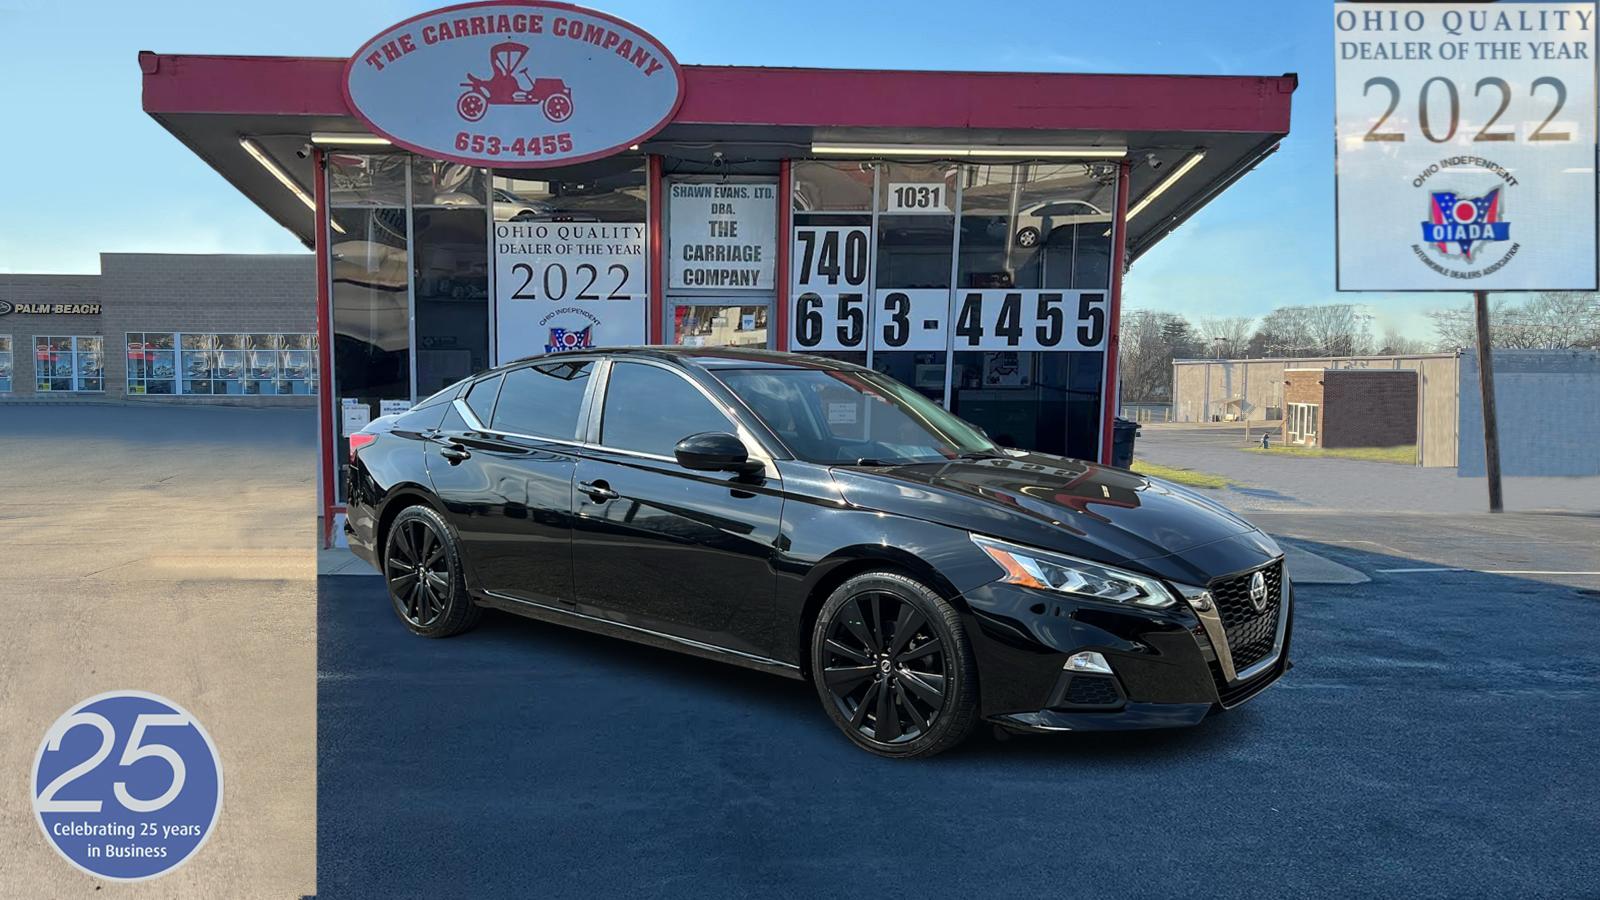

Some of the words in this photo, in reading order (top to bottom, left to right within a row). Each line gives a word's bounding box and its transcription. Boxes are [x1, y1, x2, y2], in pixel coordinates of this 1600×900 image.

[1336, 10, 1425, 32] OHIO
[1442, 9, 1593, 35] QUALITY
[366, 33, 416, 73] THE
[422, 14, 544, 46] CARRIAGE
[553, 17, 664, 77] COMPANY
[1340, 41, 1433, 60] DEALER
[1439, 41, 1469, 60] OF
[1475, 41, 1522, 60] THE
[1528, 41, 1589, 60] YEAR
[1363, 76, 1571, 143] 2022
[455, 132, 573, 157] 653-4455
[1412, 164, 1440, 188] OHIO
[1439, 155, 1519, 187] INDEPENDENT
[672, 186, 712, 199] SHAWN
[754, 186, 775, 199] LTD.
[894, 186, 940, 209] 1031
[711, 203, 736, 215] DBA.
[497, 225, 548, 239] OHIO
[558, 225, 644, 241] QUALITY
[708, 220, 738, 238] THE
[1432, 224, 1495, 241] OIADA
[500, 243, 552, 256] DEALER
[555, 243, 574, 256] OF
[576, 243, 603, 256] THE
[607, 243, 642, 256] YEAR
[683, 244, 762, 262] CARRIAGE
[797, 230, 867, 286] 740
[1410, 244, 1452, 277] AUTOMOBILE
[1449, 270, 1482, 280] DEALERS
[1482, 242, 1521, 278] ASSOCIATION
[511, 263, 632, 301] 2022
[683, 268, 760, 287] COMPANY
[14, 303, 51, 314] PALM
[54, 303, 100, 314] BEACH
[555, 307, 601, 326] INDEPENDENT
